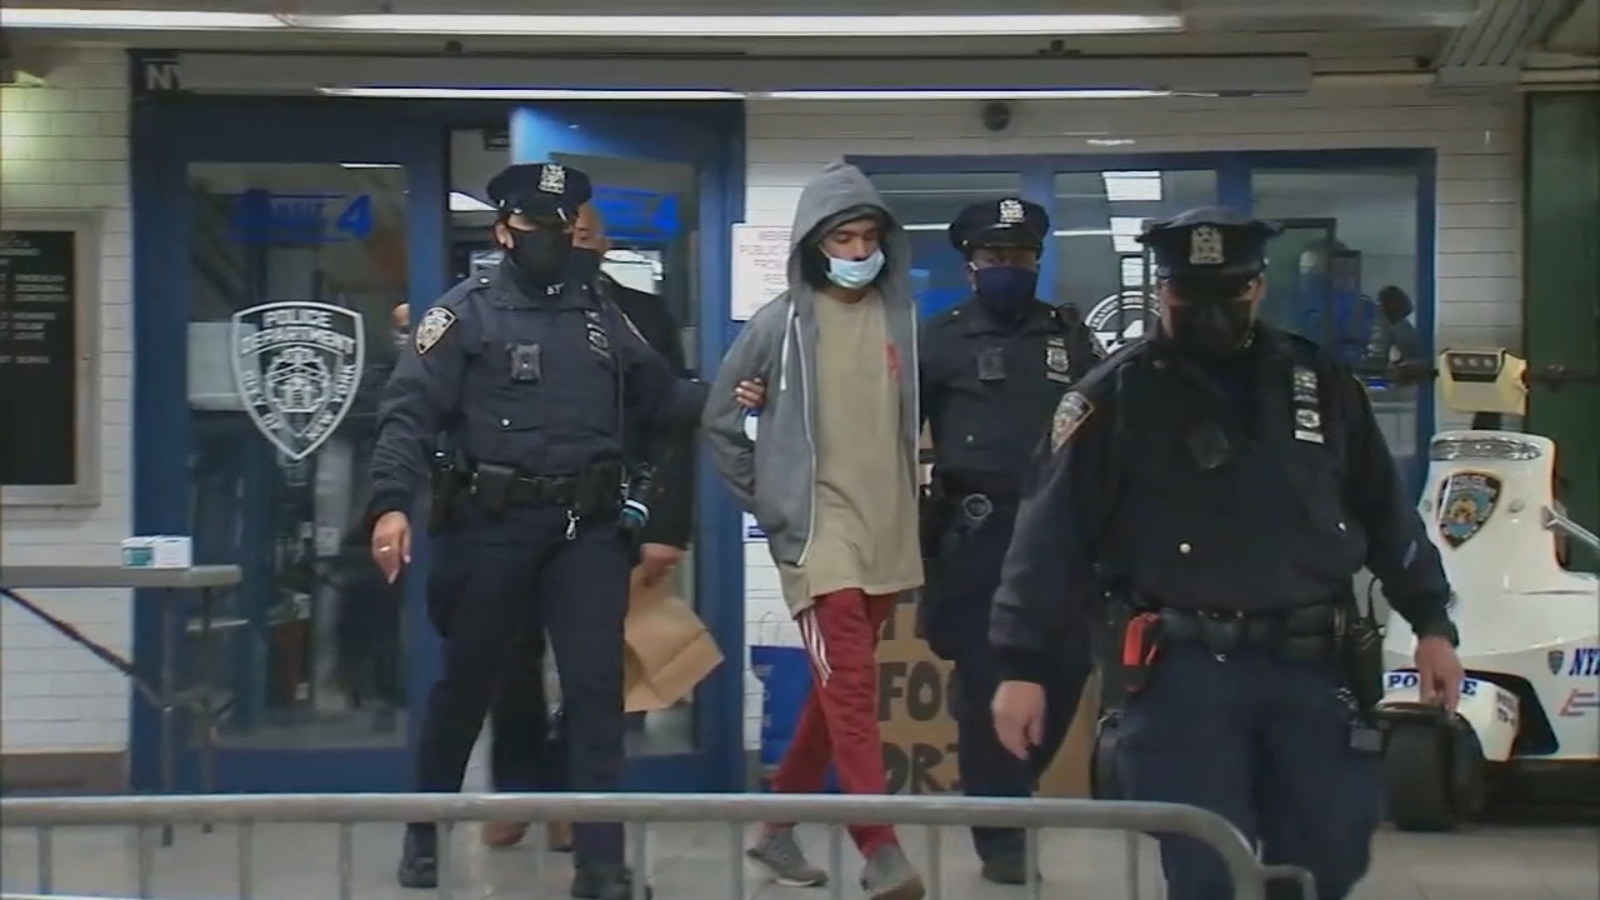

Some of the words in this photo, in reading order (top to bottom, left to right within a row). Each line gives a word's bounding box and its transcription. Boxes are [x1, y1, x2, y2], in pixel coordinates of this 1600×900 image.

[337, 194, 371, 239] 4
[263, 308, 333, 328] POLICE
[241, 325, 356, 356] DEPARTMENT
[1389, 674, 1478, 696] POE
